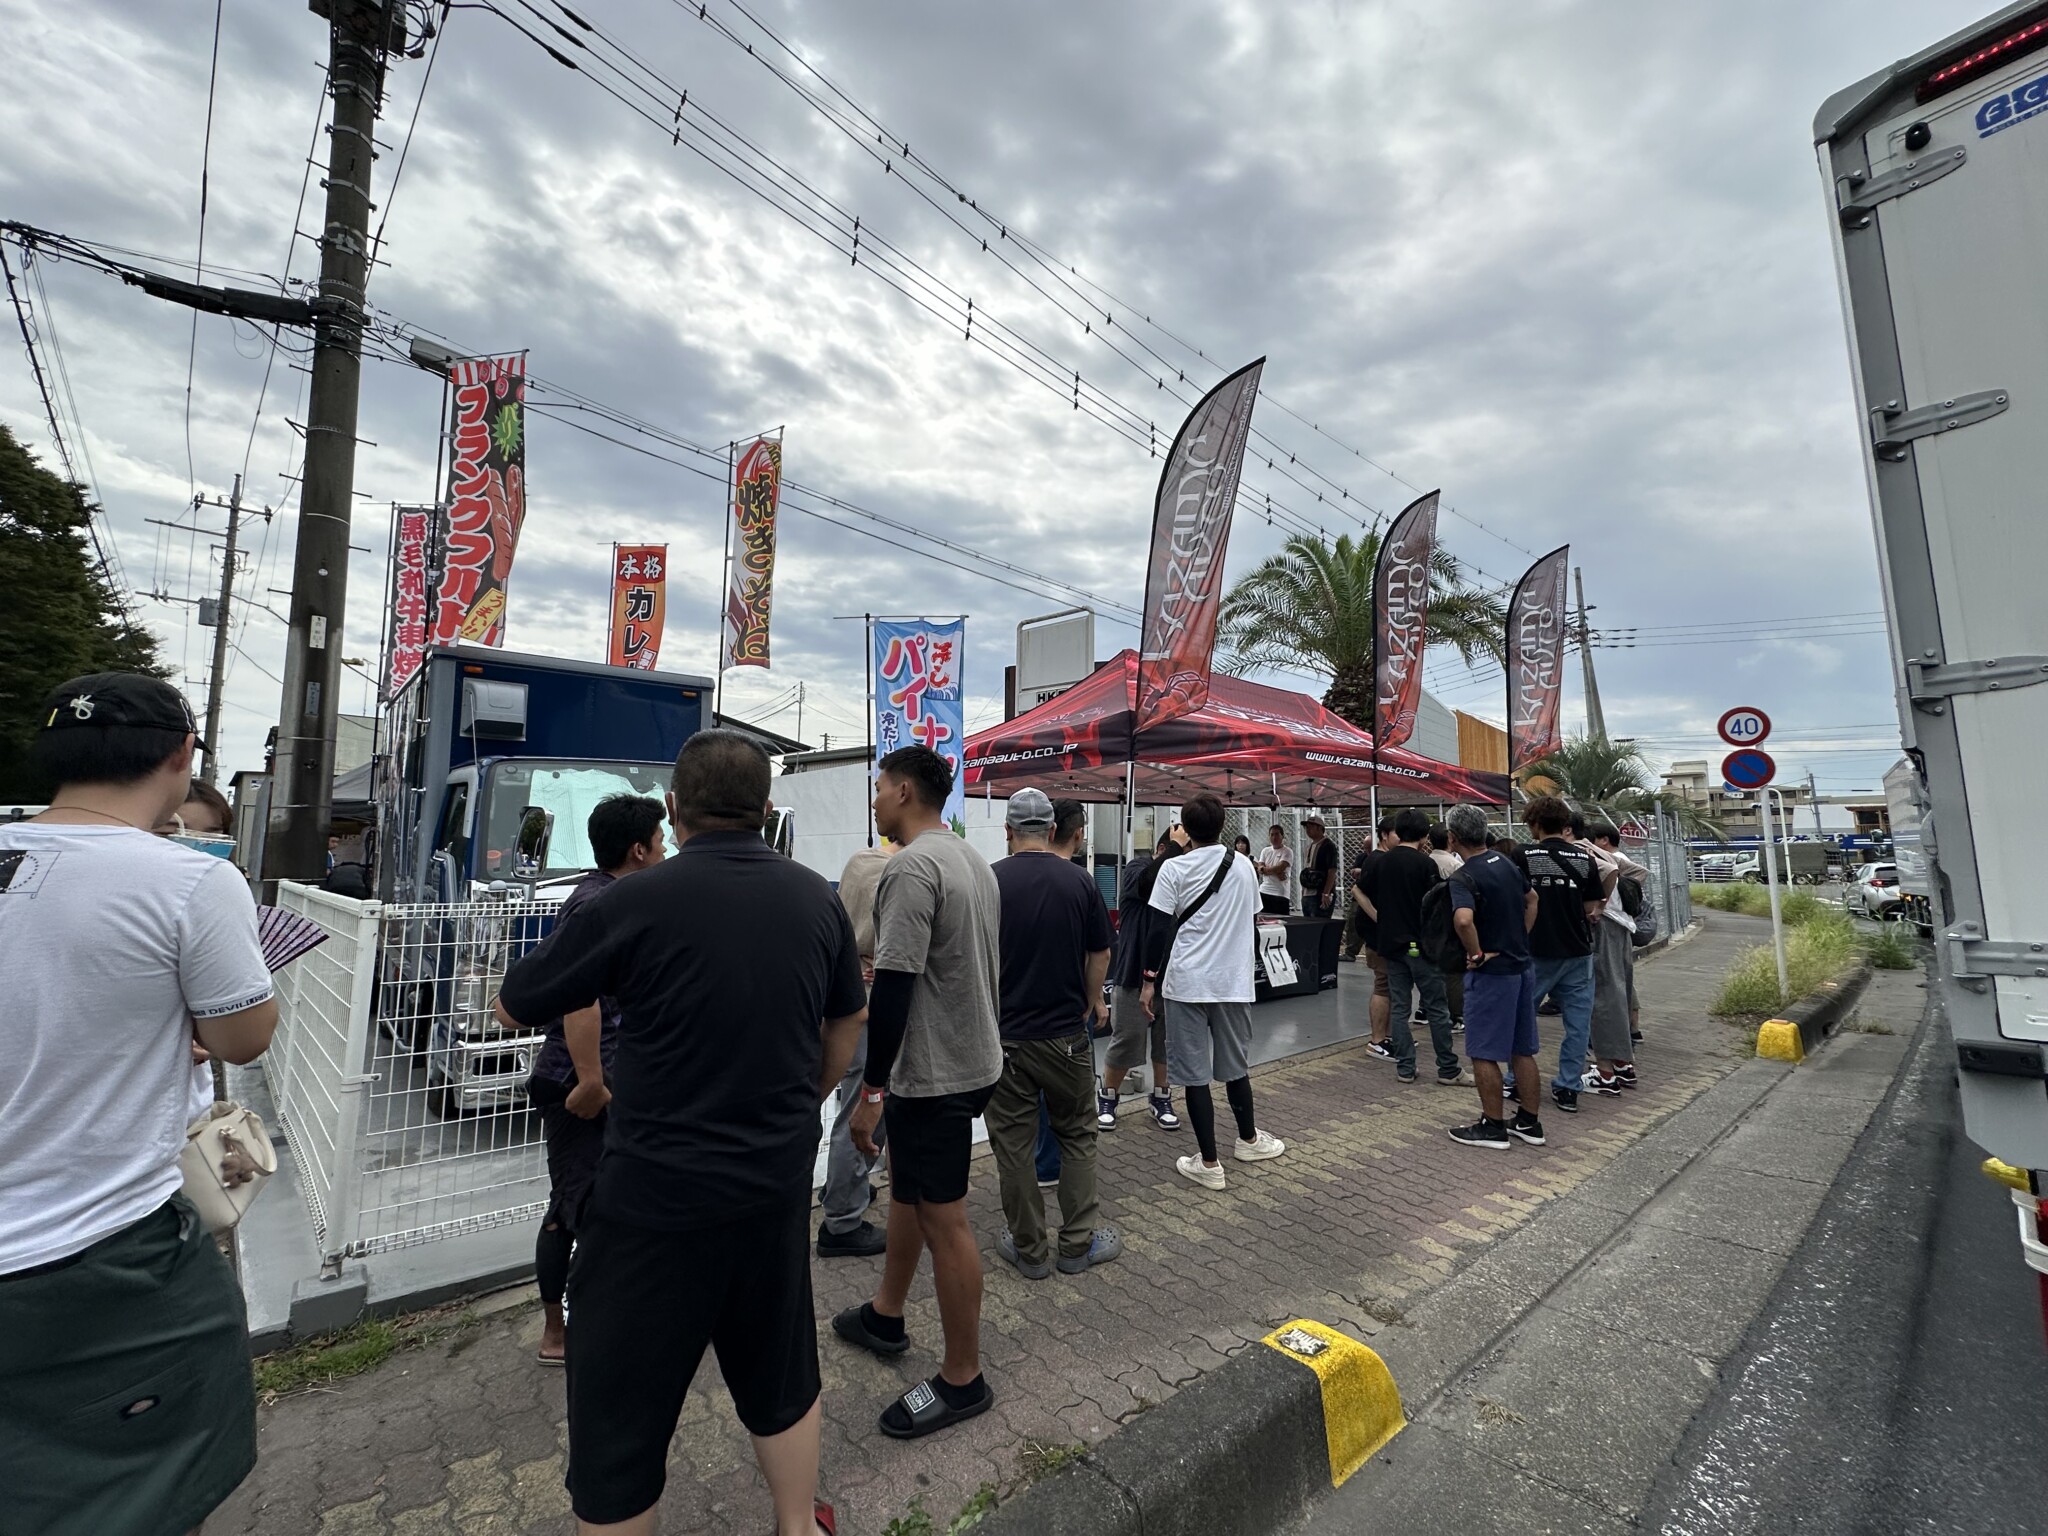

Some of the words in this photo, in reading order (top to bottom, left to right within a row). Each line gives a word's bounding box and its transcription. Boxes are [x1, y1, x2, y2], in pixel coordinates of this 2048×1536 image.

[436, 382, 494, 640] フランクフルト
[619, 554, 663, 580] 本格
[623, 585, 656, 669] カレ
[1730, 717, 1760, 736] 40
[1263, 935, 1288, 974] 付
